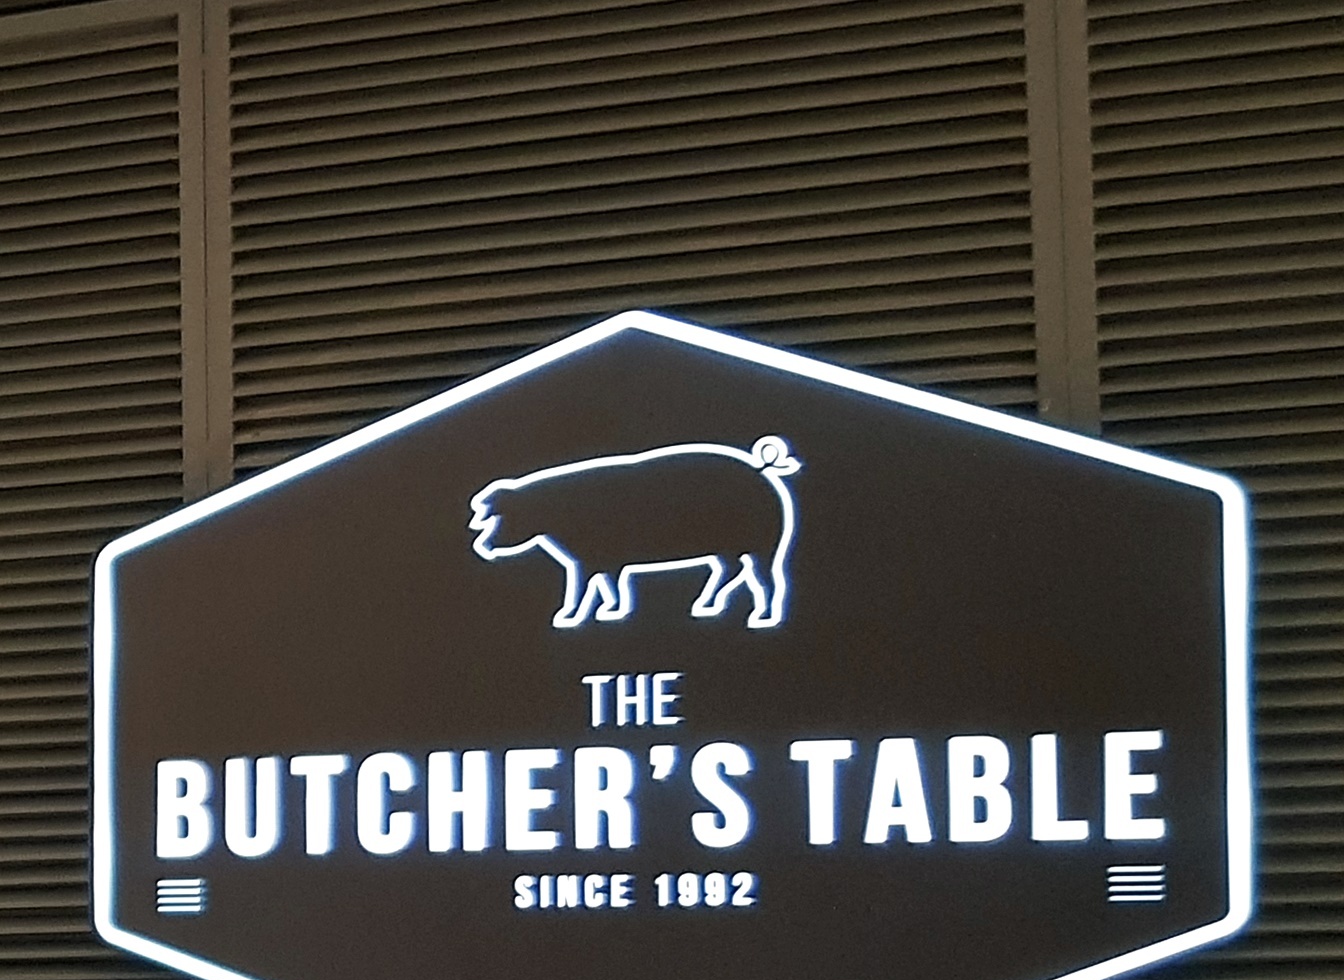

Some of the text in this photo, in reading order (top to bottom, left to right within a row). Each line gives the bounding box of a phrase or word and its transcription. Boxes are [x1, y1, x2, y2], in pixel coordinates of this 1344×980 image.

[582, 671, 684, 727] THE
[154, 730, 1167, 860] BUTCHER'S TABLE
[513, 870, 757, 909] SINCE 1992
